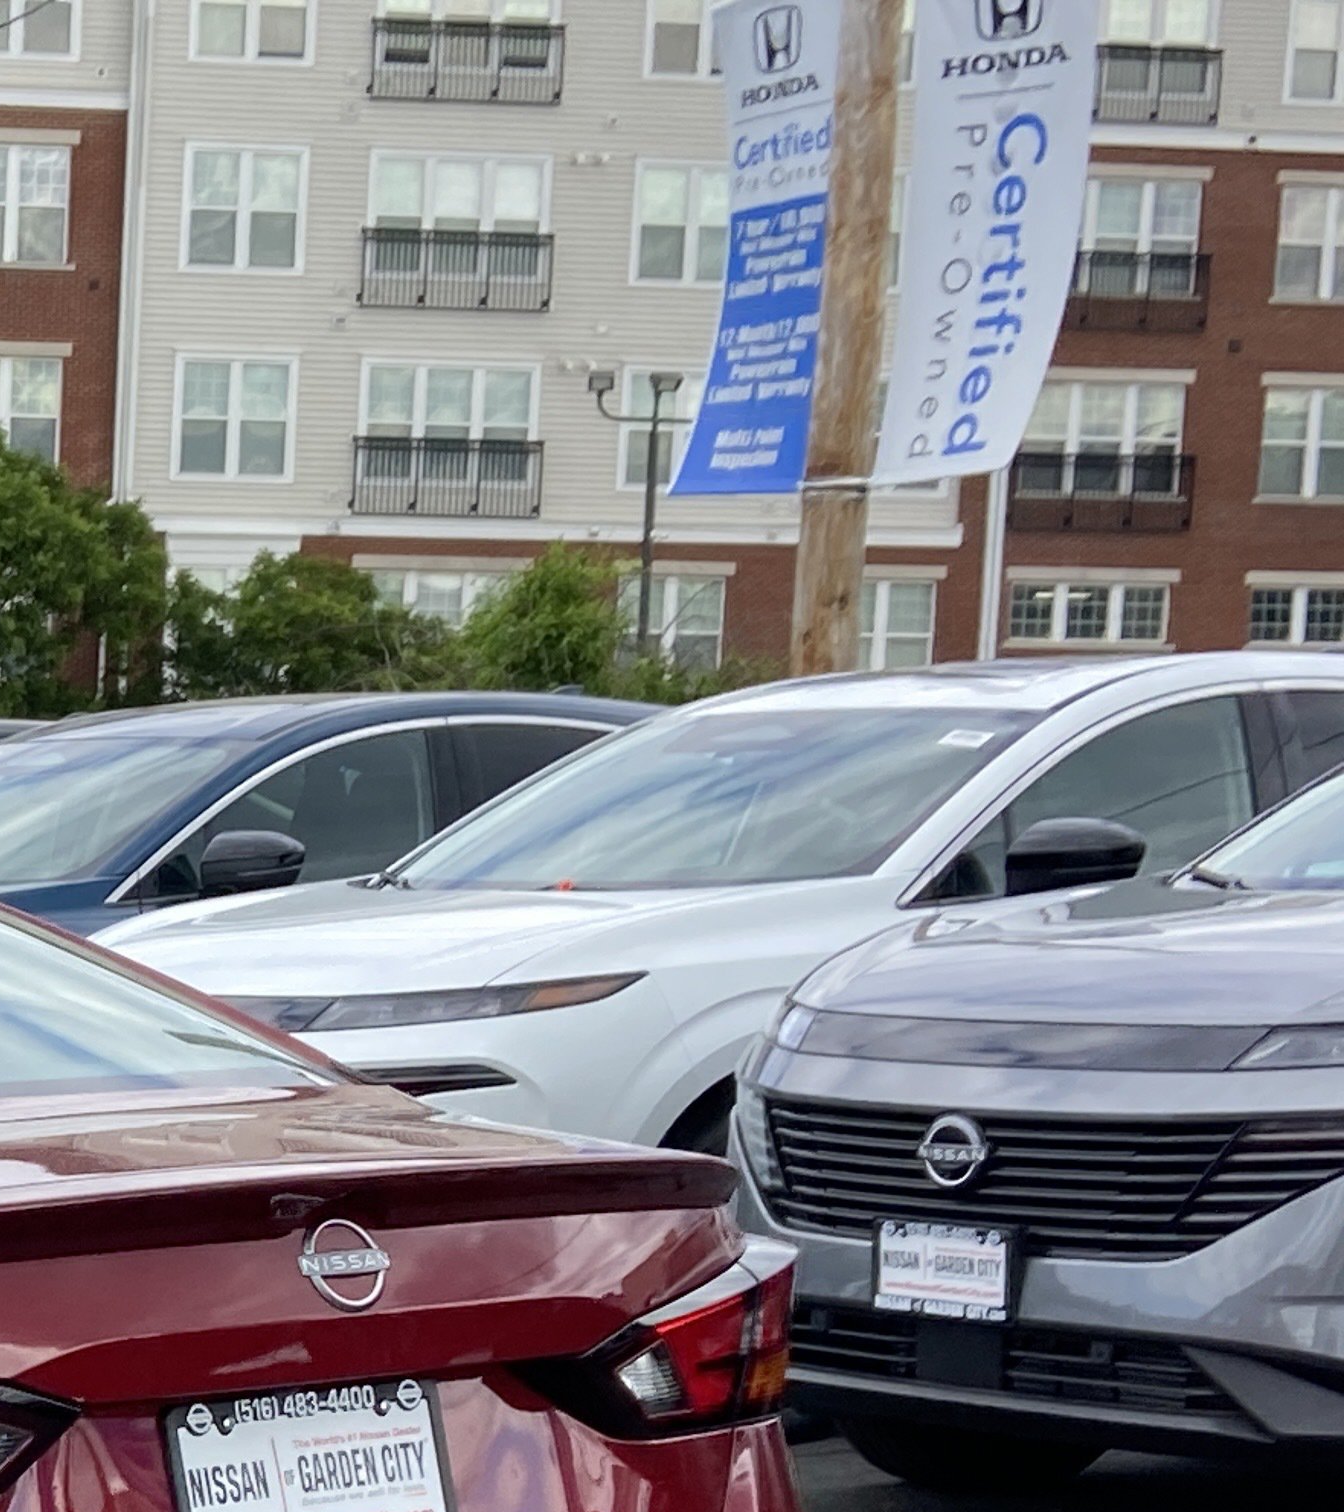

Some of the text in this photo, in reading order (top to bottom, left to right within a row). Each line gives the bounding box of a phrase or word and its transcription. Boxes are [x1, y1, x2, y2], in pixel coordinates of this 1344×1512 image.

[941, 42, 1071, 79] HONDA
[741, 73, 819, 108] HONDA
[733, 115, 832, 170] Certified
[908, 123, 988, 459] Pre-Owned
[941, 112, 1048, 456] Certified
[301, 1251, 391, 1273] NISSAN
[977, 1258, 1001, 1277] CITY
[234, 1384, 375, 1423] (516) 483-4400
[188, 1460, 270, 1508] NISSAN
[297, 1446, 379, 1493] GARDEN
[381, 1440, 425, 1483] CITY
